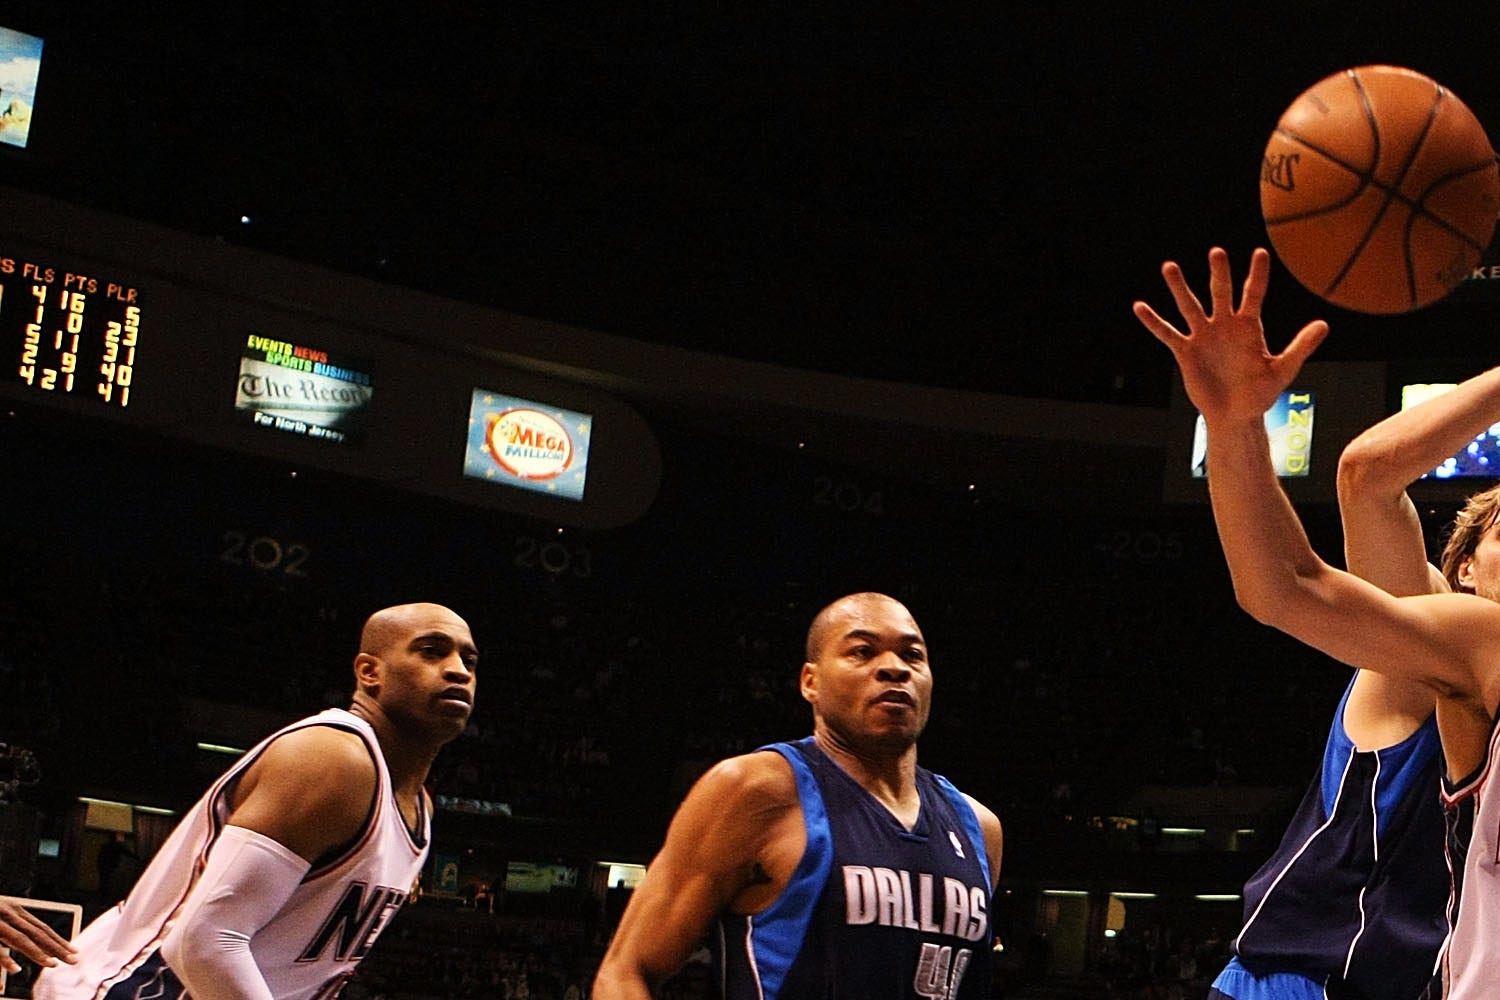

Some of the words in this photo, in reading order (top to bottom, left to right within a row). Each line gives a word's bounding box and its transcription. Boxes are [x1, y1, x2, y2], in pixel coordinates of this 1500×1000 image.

[23, 263, 55, 283] FLS
[64, 273, 98, 293] PTS
[107, 283, 138, 303] PLR
[32, 285, 47, 304] 4
[60, 290, 86, 314] 16
[126, 306, 141, 327] 5
[36, 305, 44, 324] 1
[67, 312, 83, 334] 0
[105, 321, 138, 347] 23
[22, 343, 39, 365] 2
[61, 352, 77, 373] 9
[101, 362, 133, 386] 40
[25, 323, 41, 344] 5
[103, 341, 135, 366] 31
[248, 335, 293, 356] EVENTS
[294, 345, 328, 363] NEWS
[266, 350, 313, 373] SPORTS
[20, 365, 35, 386] 4
[98, 383, 130, 407] 41
[240, 372, 293, 398] The
[254, 412, 274, 425] For
[275, 416, 307, 434] North
[308, 424, 344, 442] Jersey
[508, 422, 566, 452] MEGA
[1287, 393, 1310, 473] IZOD
[220, 530, 310, 577] 202
[294, 881, 409, 962] NE
[841, 864, 988, 942] DALLAS
